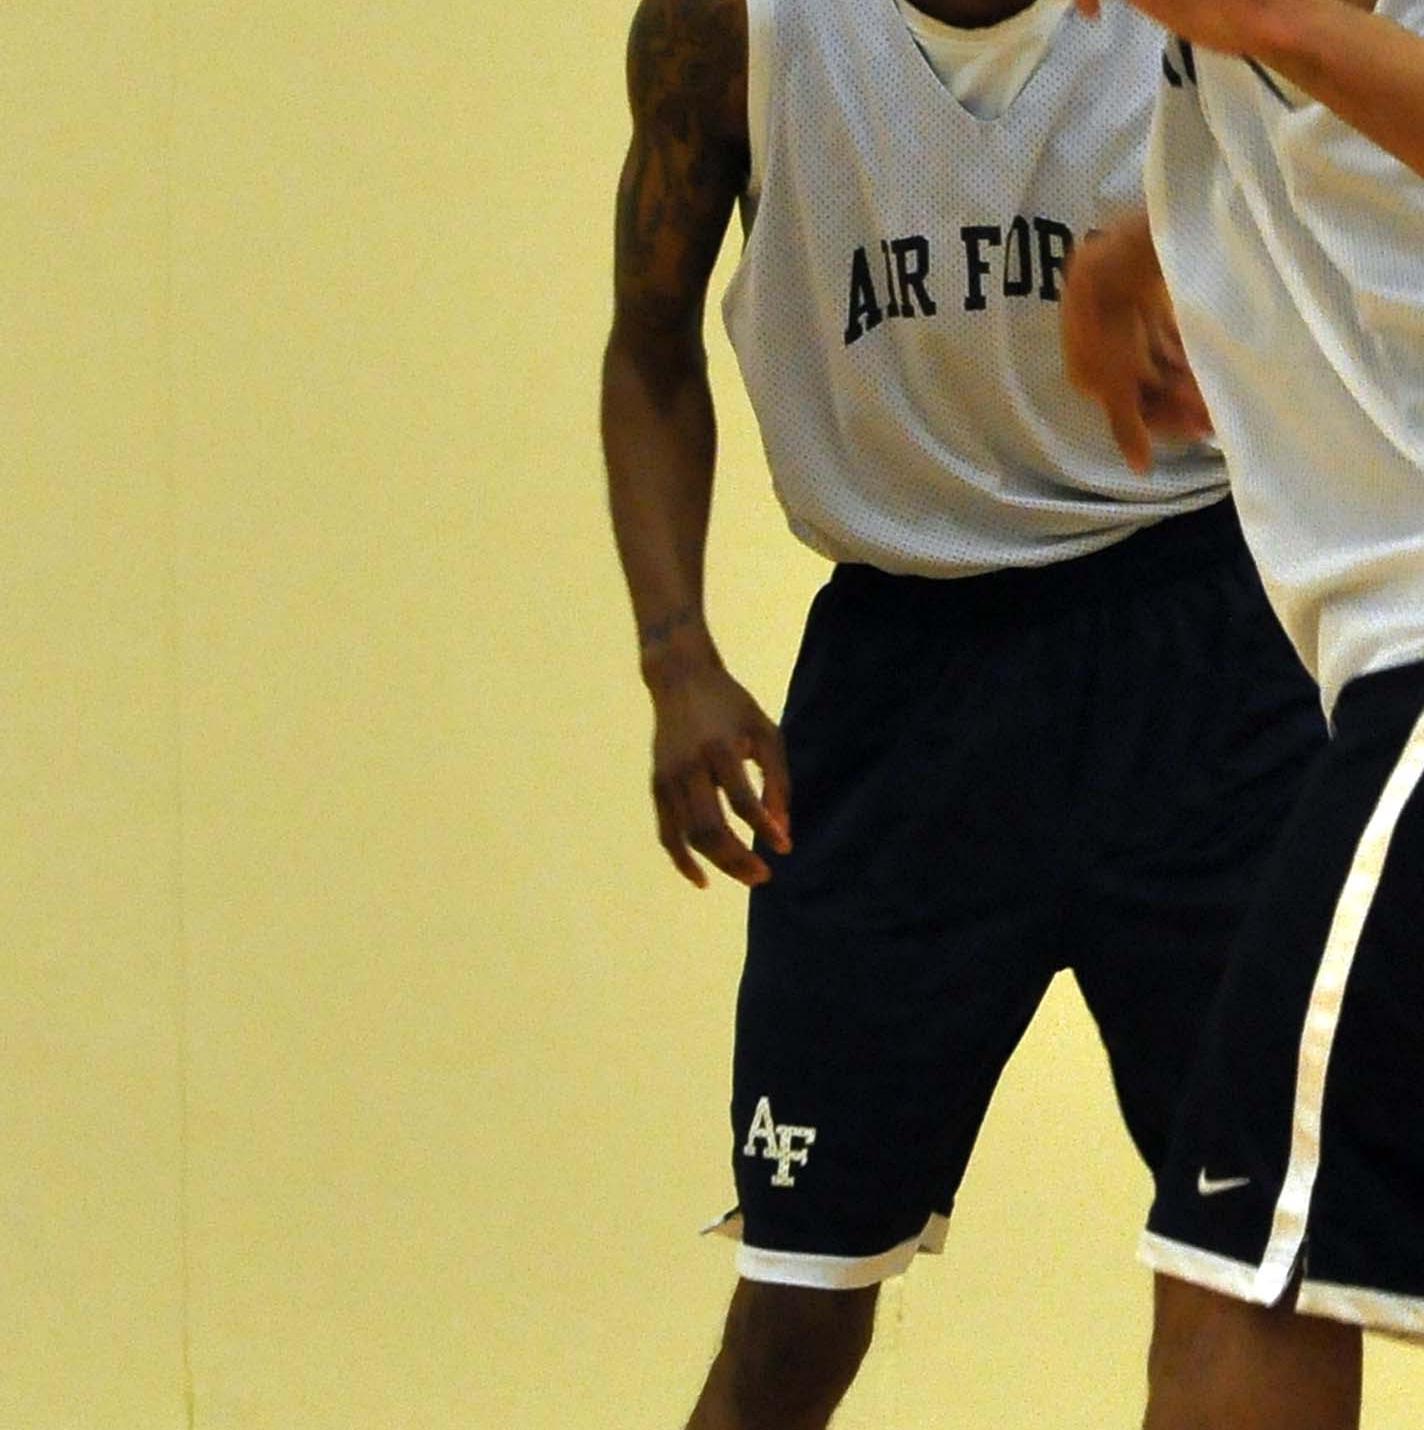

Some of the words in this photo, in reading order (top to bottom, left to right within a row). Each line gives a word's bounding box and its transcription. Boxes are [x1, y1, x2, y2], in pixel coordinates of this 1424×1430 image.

[844, 234, 937, 345] AIR
[961, 214, 1099, 312] FOR
[743, 1095, 817, 1187] AF
